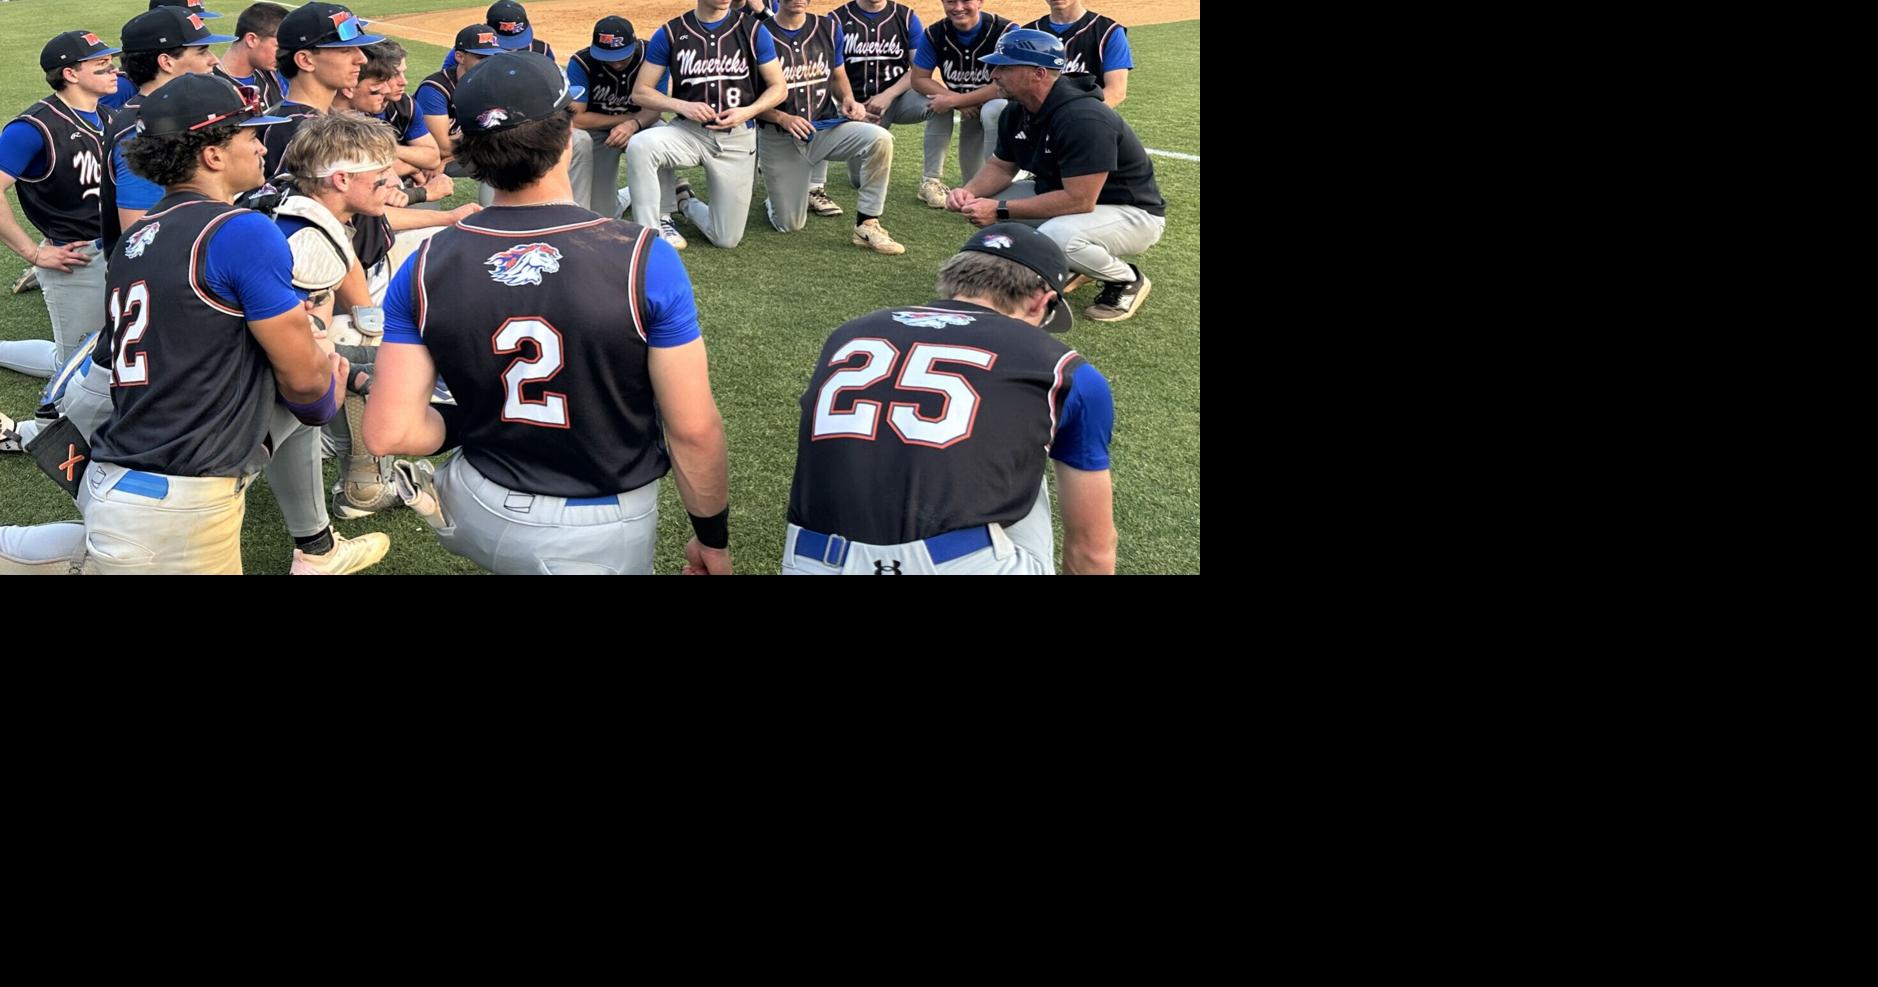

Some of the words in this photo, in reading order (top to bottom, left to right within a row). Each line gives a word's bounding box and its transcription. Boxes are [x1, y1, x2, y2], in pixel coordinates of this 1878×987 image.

[844, 33, 904, 57] Mavericks
[677, 49, 750, 77] Mavericks
[780, 52, 831, 80] avericks
[942, 59, 991, 83] Maverick
[726, 87, 741, 107] 8
[816, 88, 827, 108] 7
[109, 280, 149, 387] 12
[492, 316, 570, 428] 2
[812, 337, 998, 449] 25
